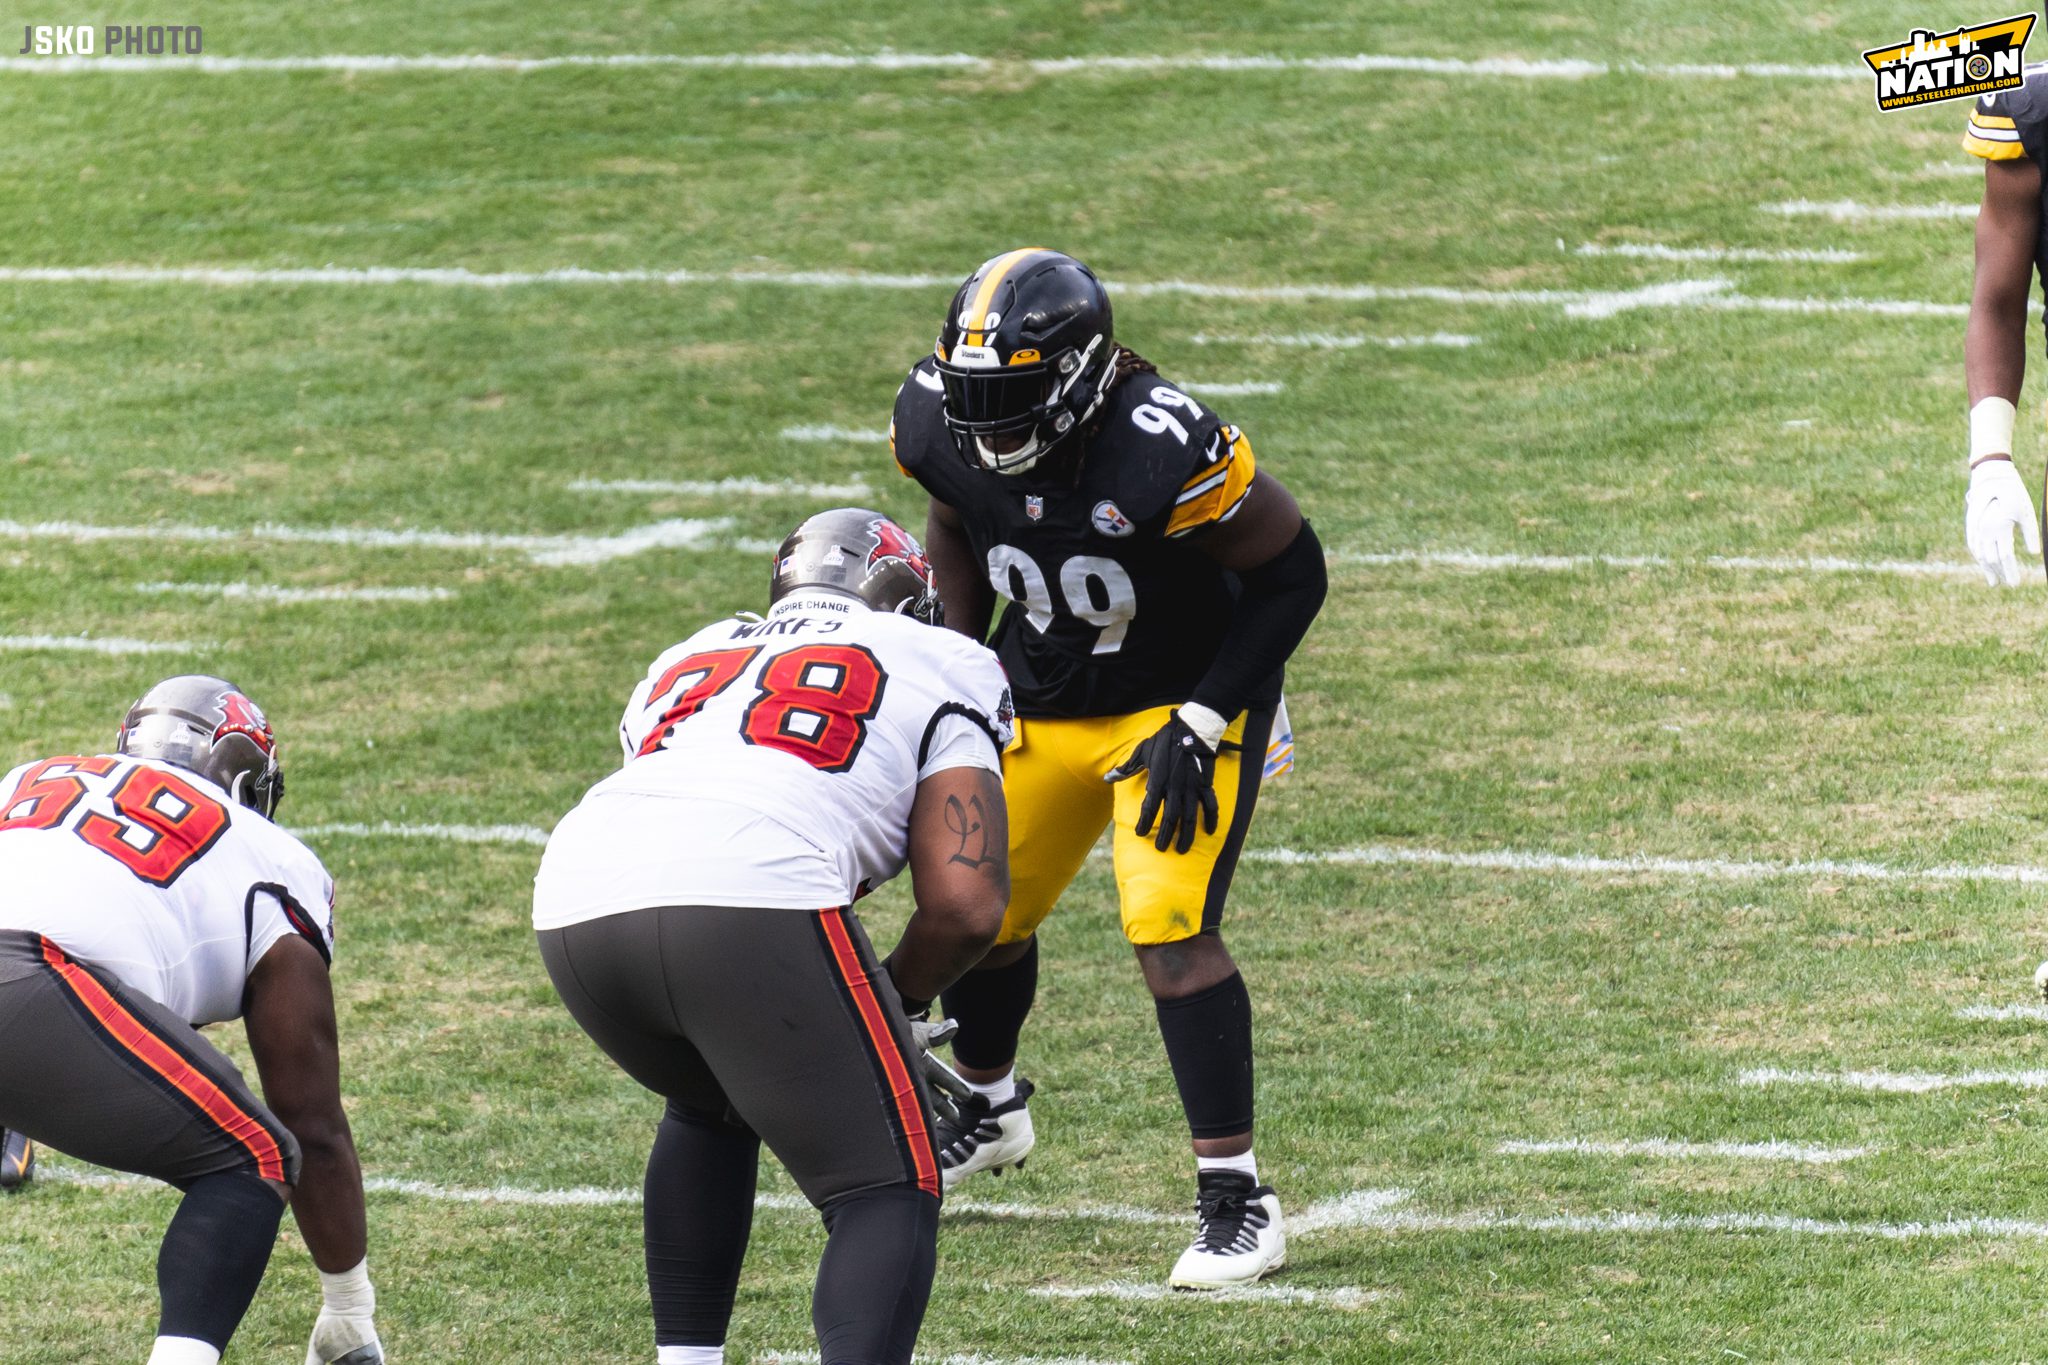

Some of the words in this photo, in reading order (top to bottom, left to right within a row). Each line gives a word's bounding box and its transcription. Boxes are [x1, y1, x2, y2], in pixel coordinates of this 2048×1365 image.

[1131, 386, 1204, 445] 99
[774, 602, 803, 617] INSPIRE
[806, 600, 850, 613] CHANGE
[987, 544, 1136, 655] 99
[633, 642, 889, 774] 78
[0, 755, 231, 889] 69
